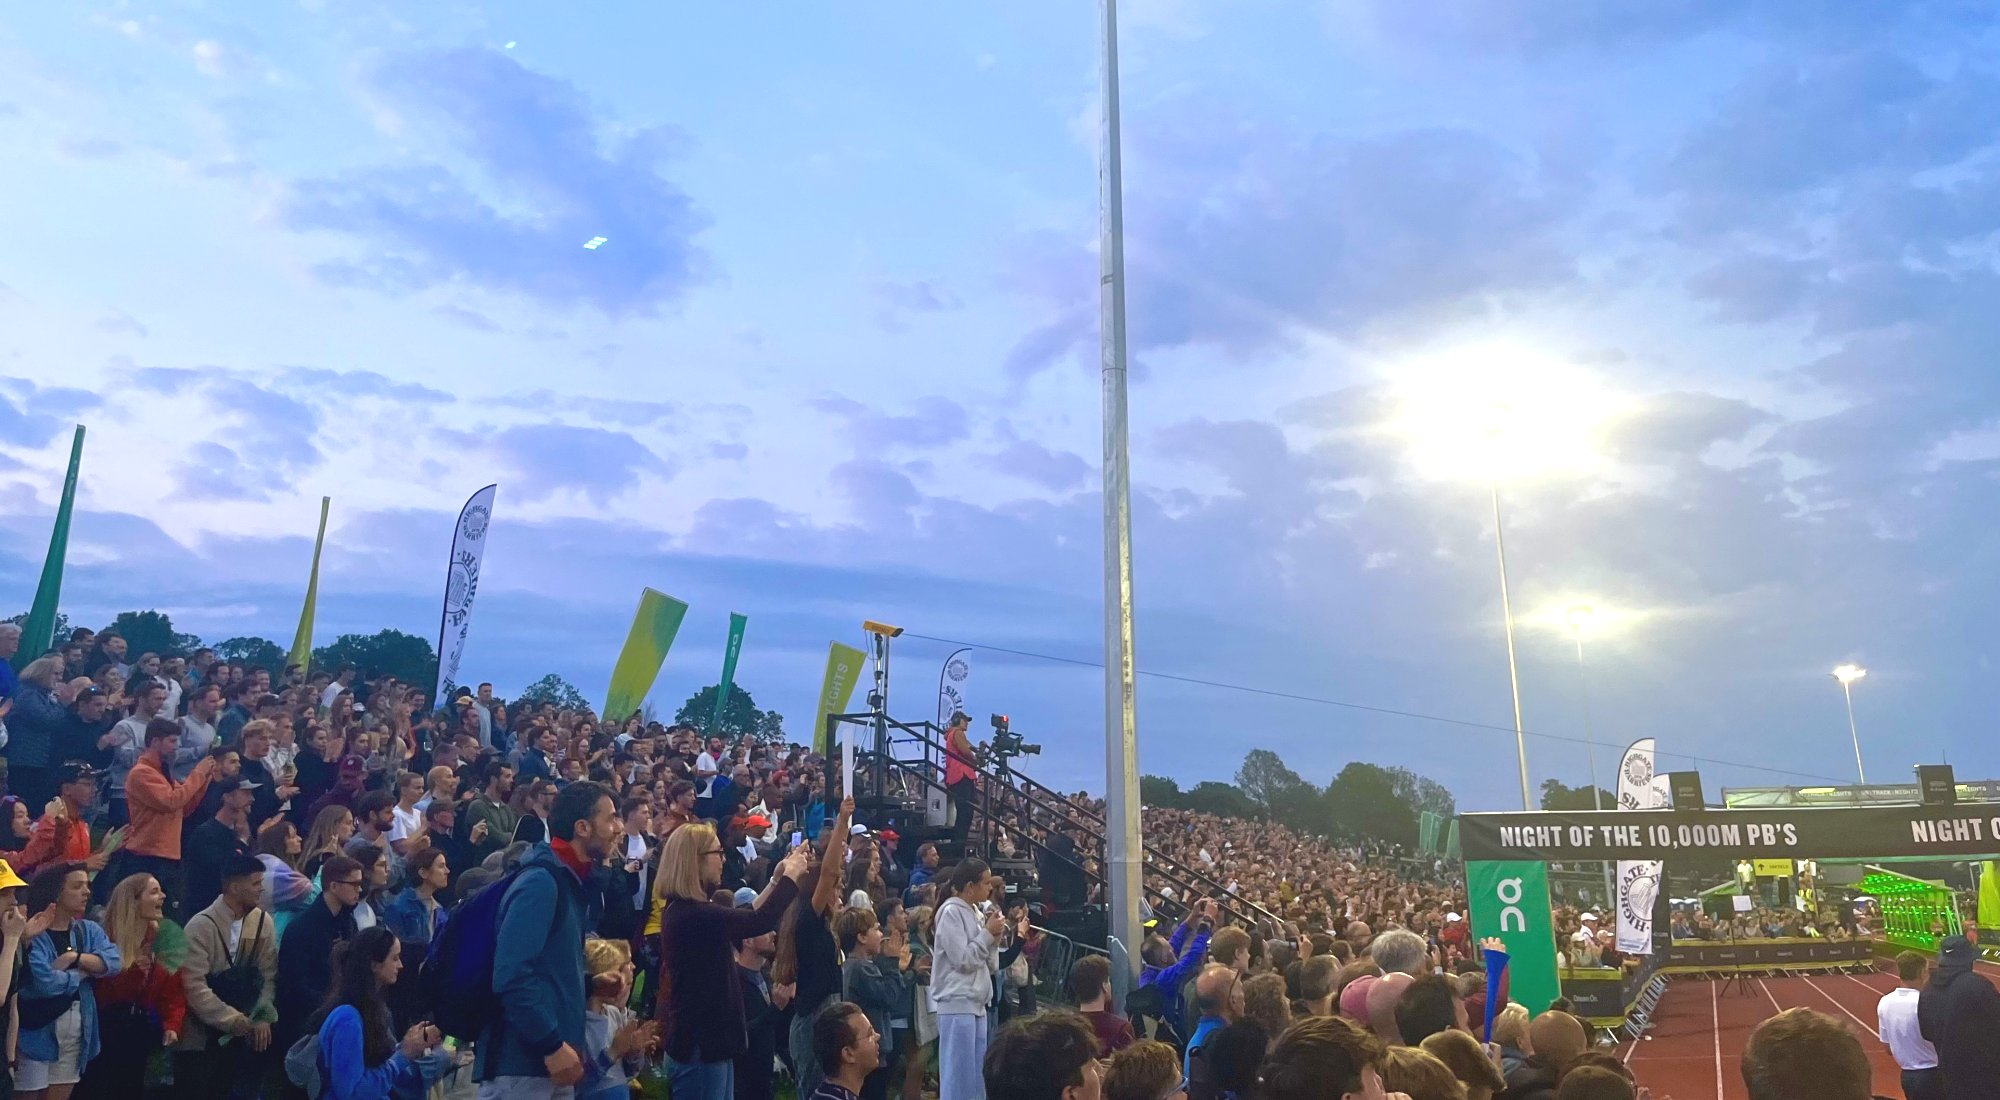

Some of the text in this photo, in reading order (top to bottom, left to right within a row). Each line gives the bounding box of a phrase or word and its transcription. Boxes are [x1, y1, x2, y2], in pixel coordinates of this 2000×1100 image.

[1624, 753, 1652, 769] HIGHGATE
[1500, 823, 1798, 849] NIGHT OF THE 10,000M PB'S
[1910, 818, 1983, 843] NIGHT
[1620, 864, 1648, 932] HIGHGATE
